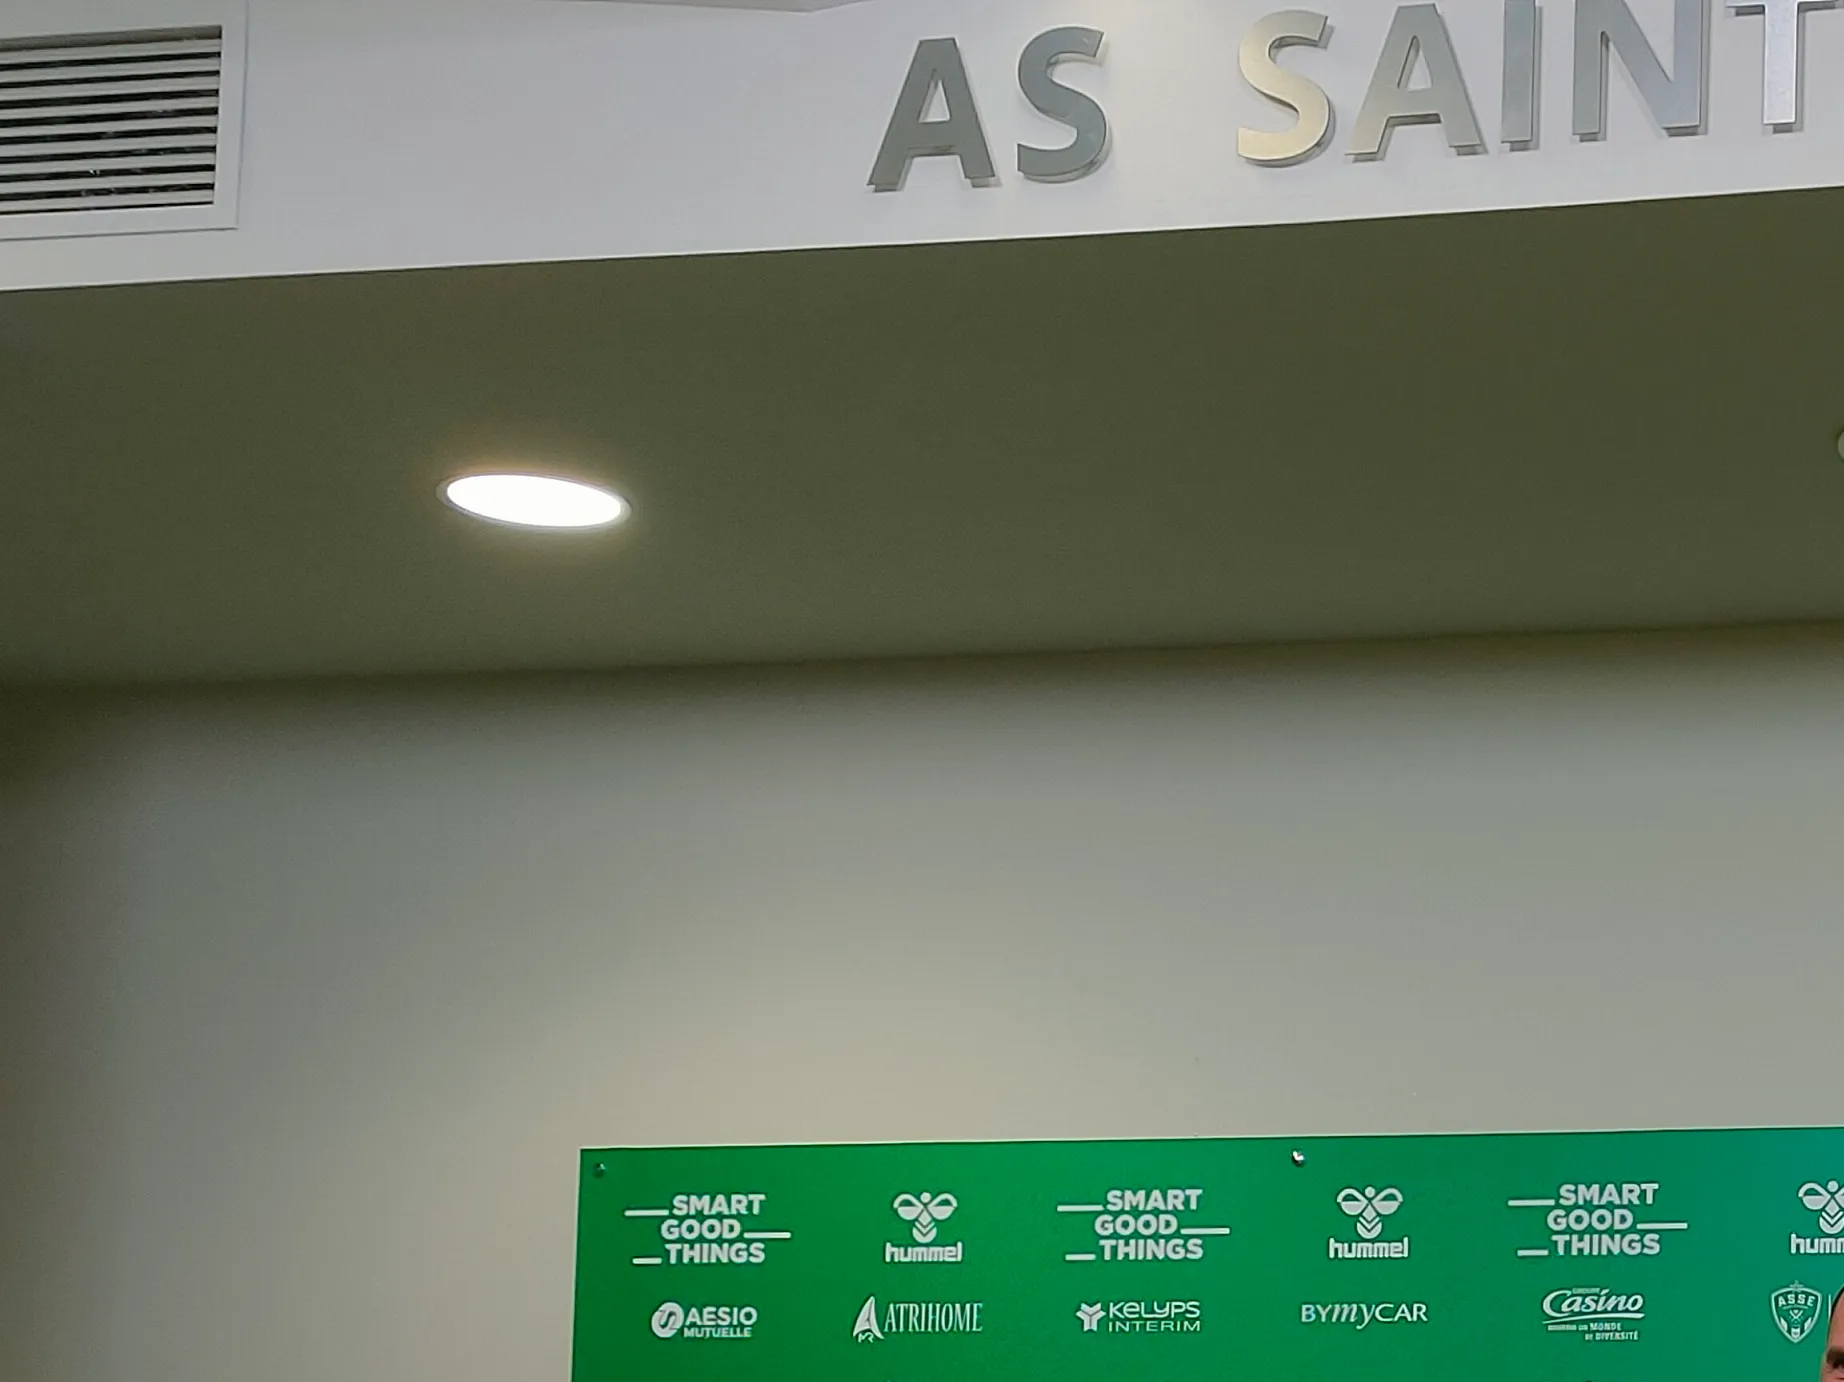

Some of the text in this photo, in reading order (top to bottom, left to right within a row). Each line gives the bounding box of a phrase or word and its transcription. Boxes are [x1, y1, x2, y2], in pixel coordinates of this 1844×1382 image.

[866, 25, 1107, 191] AS
[672, 1194, 766, 1215] SMART
[1107, 1189, 1202, 1211] SMART
[1559, 1183, 1659, 1205] SMART
[661, 1219, 741, 1240] GOOD
[1095, 1214, 1178, 1236] GOOD
[1547, 1209, 1633, 1231] GOOD
[665, 1242, 765, 1264] THINGS
[885, 1242, 962, 1262] hummel
[1099, 1238, 1203, 1260] THINGS
[1329, 1237, 1408, 1258] hummel
[1551, 1233, 1660, 1255] THINGS
[1543, 1288, 1643, 1317] Casino
[1777, 1293, 1816, 1309] ASSE
[885, 1303, 982, 1332] ATRIHOME
[1109, 1321, 1200, 1332] INTERIM
[684, 1327, 751, 1337] MUTUELLE
